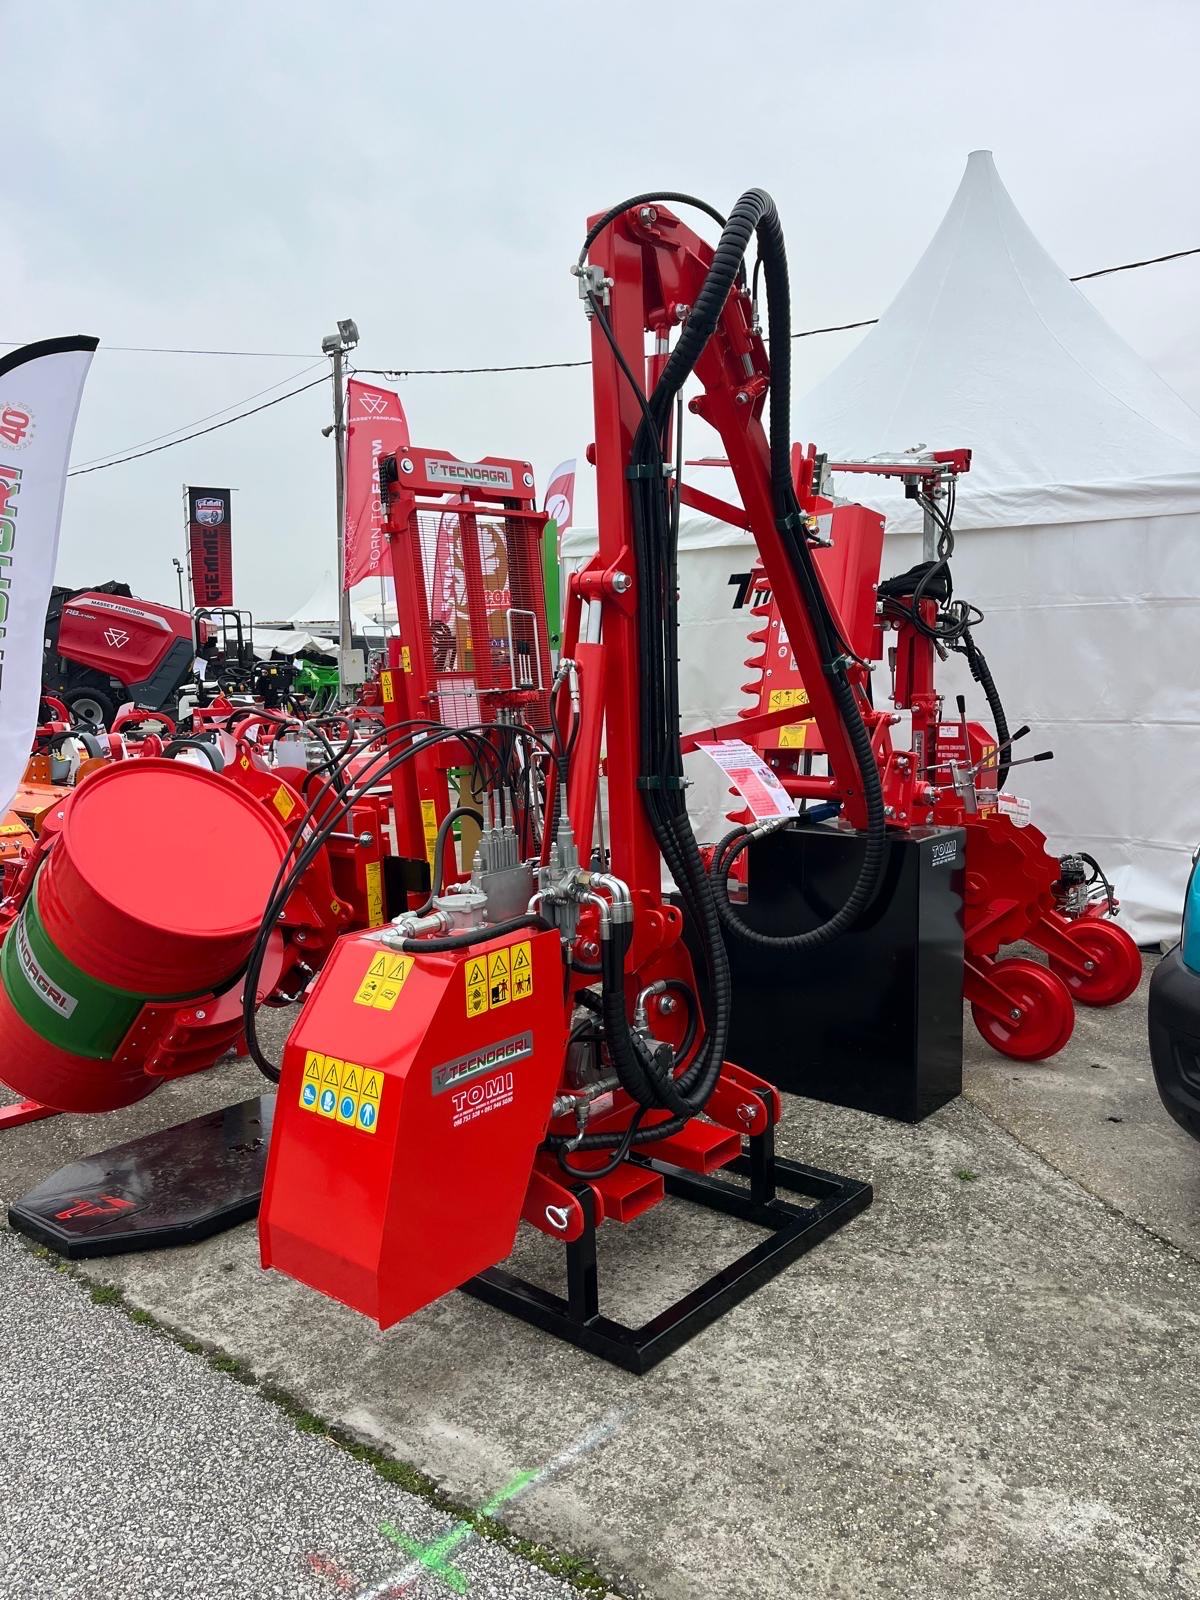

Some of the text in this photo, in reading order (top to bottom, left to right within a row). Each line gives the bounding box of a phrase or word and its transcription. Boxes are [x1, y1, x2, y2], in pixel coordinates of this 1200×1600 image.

[440, 464, 508, 483] TECNOAGRI
[371, 500, 383, 522] TO
[370, 528, 382, 570] BORN
[91, 600, 145, 617] MASSEY FERGUSON
[932, 840, 957, 858] TOMI
[449, 1038, 527, 1079] TECNOAGRI
[452, 1072, 513, 1111] TOMI
